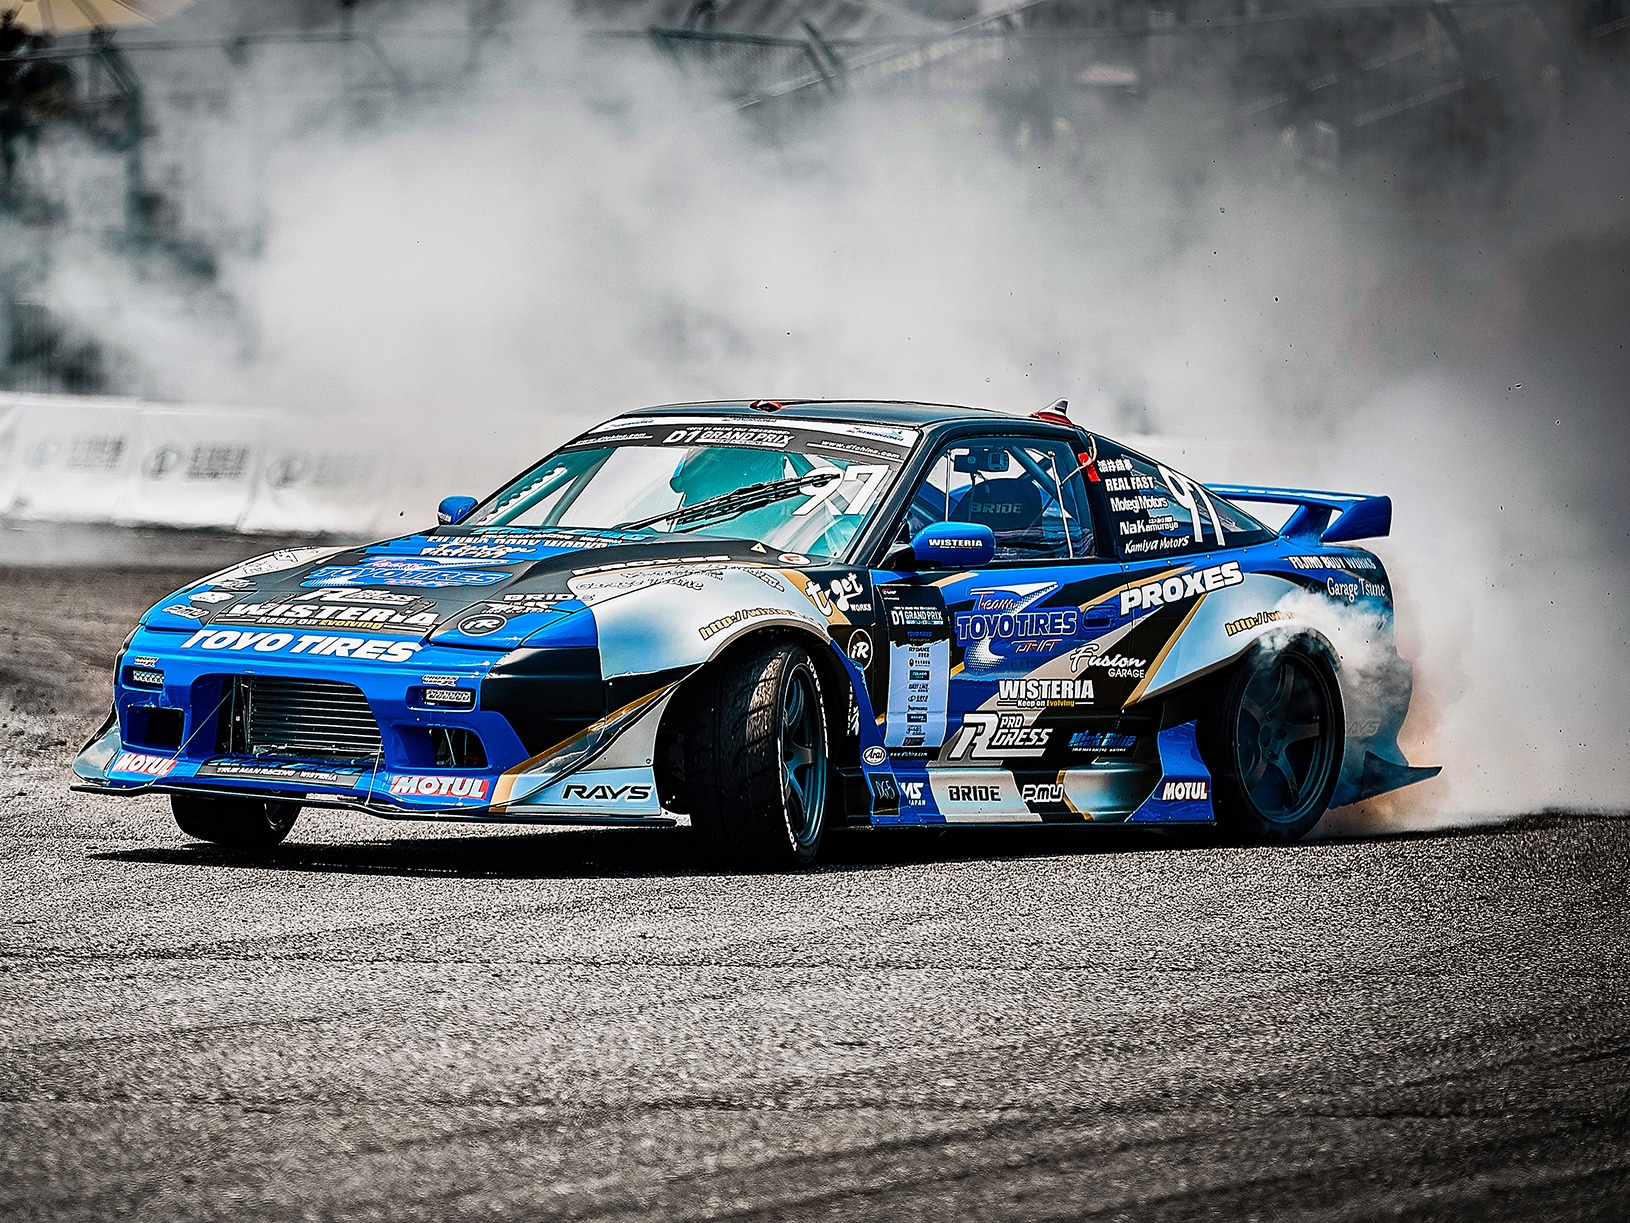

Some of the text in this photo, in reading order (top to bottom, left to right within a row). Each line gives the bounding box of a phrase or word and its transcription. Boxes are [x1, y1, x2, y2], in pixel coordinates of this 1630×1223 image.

[792, 465, 890, 516] 97
[1105, 476, 1154, 492] REAL FAST
[971, 503, 1023, 514] BRIDE
[1160, 536, 1189, 549] Motors
[1120, 561, 1243, 615] PROXES
[1327, 577, 1385, 602] Garage Tsune
[850, 603, 872, 612] WORKS
[970, 591, 1018, 610] Team
[226, 603, 440, 627] WISTERIA
[891, 610, 943, 625] D1 GRAND PRIX
[957, 612, 1077, 640] TOYO TIRES
[181, 630, 423, 662] TOYO TIRES
[1071, 644, 1146, 671] Fusion
[1108, 668, 1144, 678] GARAGE
[999, 680, 1094, 699] WISTERIA
[1000, 716, 1023, 728] PRO
[991, 728, 1053, 746] GRESS
[113, 754, 176, 775] MOTUL
[397, 776, 486, 799] MOTUL
[562, 785, 653, 800] RAYS
[948, 785, 1001, 801] BRIDE
[1162, 782, 1208, 800] MOTUL
